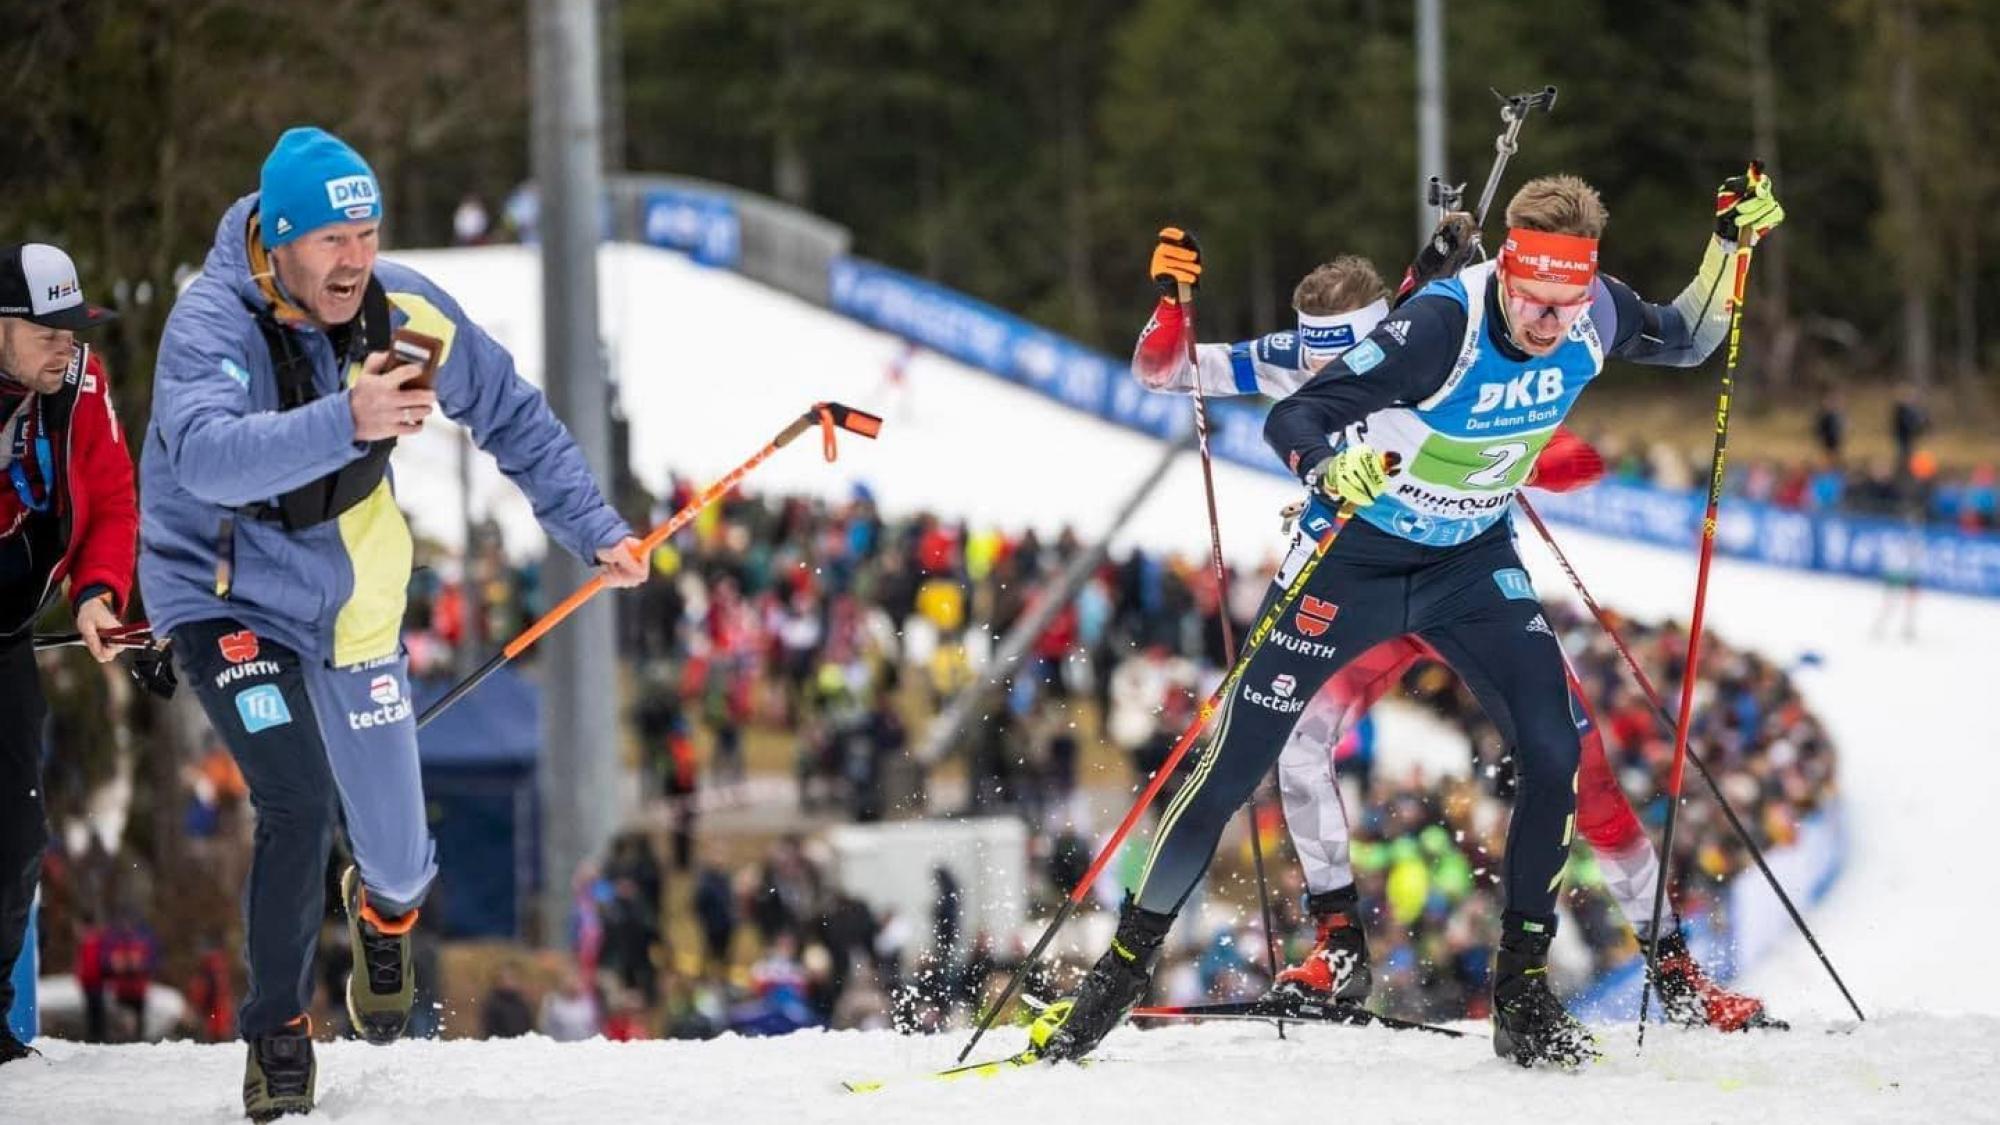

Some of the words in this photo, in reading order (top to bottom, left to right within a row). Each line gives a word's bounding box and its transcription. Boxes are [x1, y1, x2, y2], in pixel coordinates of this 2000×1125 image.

[334, 181, 373, 203] DKB
[1302, 327, 1348, 338] pure
[1470, 367, 1565, 414] DKB
[1466, 418, 1490, 430] Das
[1493, 415, 1524, 427] kann
[1528, 407, 1558, 423] Bank
[1461, 441, 1529, 487] 2
